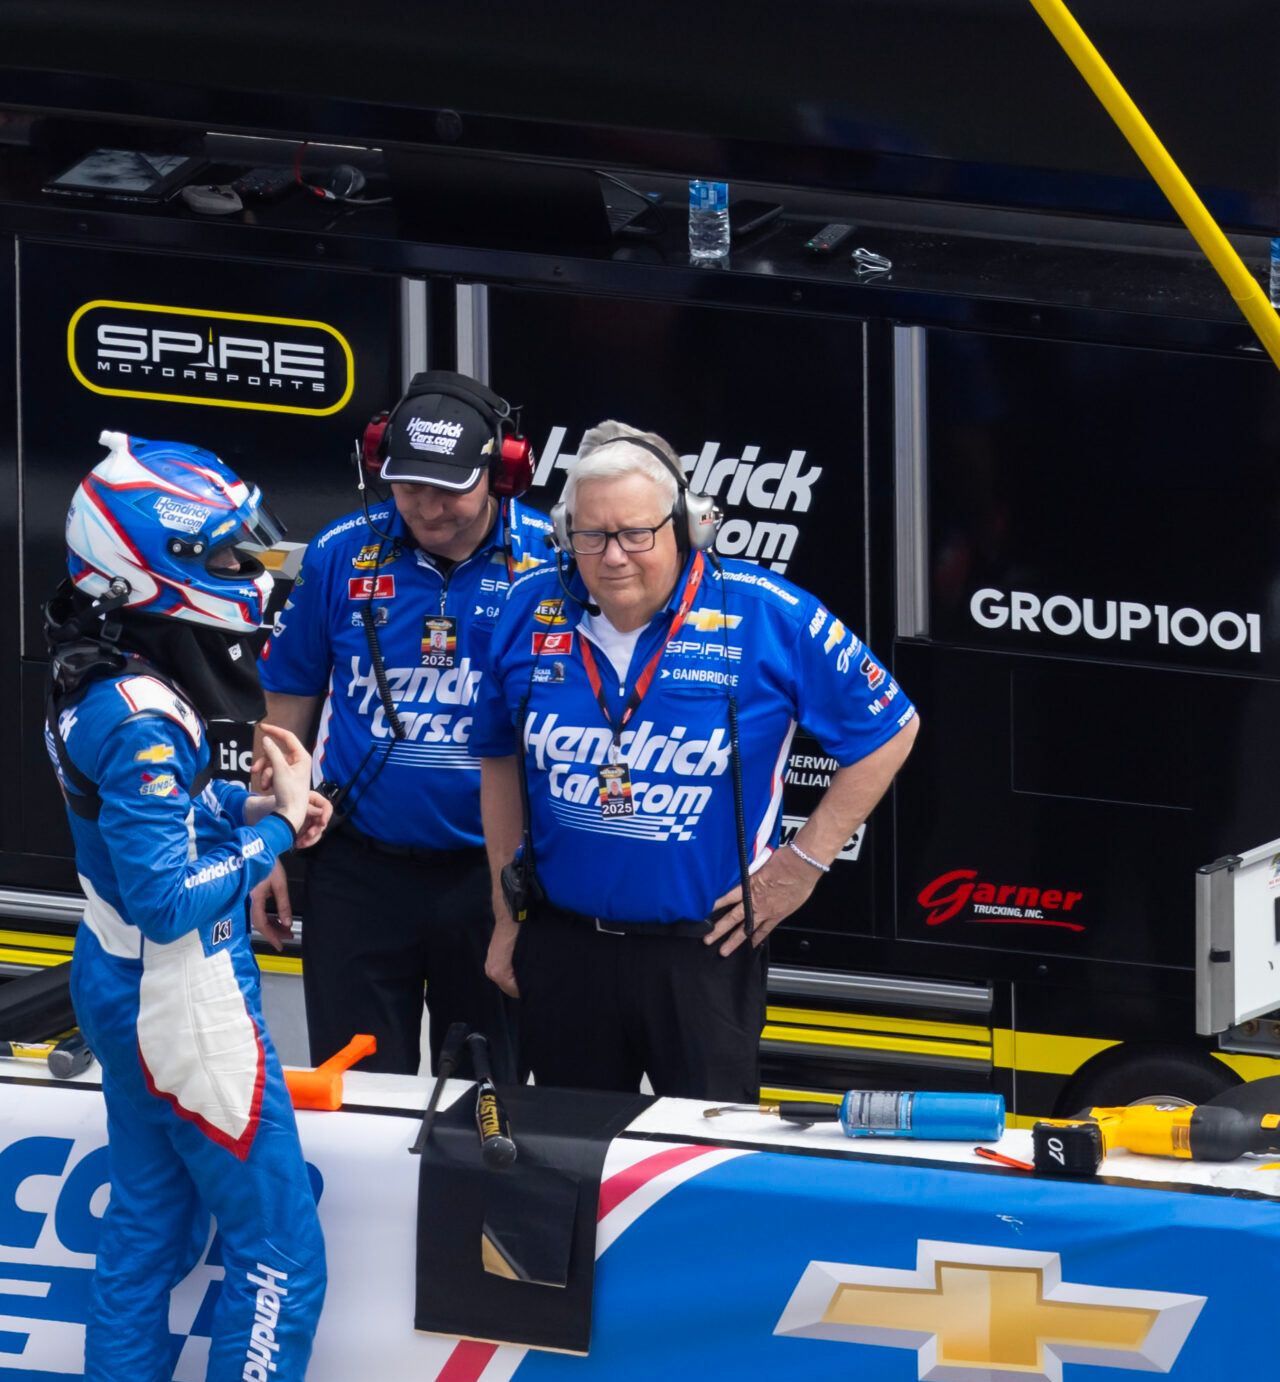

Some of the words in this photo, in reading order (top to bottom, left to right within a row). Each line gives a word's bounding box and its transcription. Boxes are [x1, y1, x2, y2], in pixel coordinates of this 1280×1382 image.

[96, 324, 326, 379] SPIRE
[97, 361, 326, 392] MOTORSPORTS
[406, 417, 464, 438] Hendrick
[411, 432, 457, 448] Cars.com
[531, 426, 823, 513] Hdrick
[154, 496, 210, 520] Hendrick
[161, 509, 204, 530] Cars.com
[969, 587, 1262, 654] GROUP1001
[421, 655, 454, 667] 2025
[672, 668, 739, 687] GAINBRIDGE
[524, 710, 732, 778] Hendrick
[602, 801, 633, 815] 2025
[916, 868, 1084, 926] Garner
[1024, 907, 1045, 919] INC.
[478, 1093, 501, 1139] EASTON
